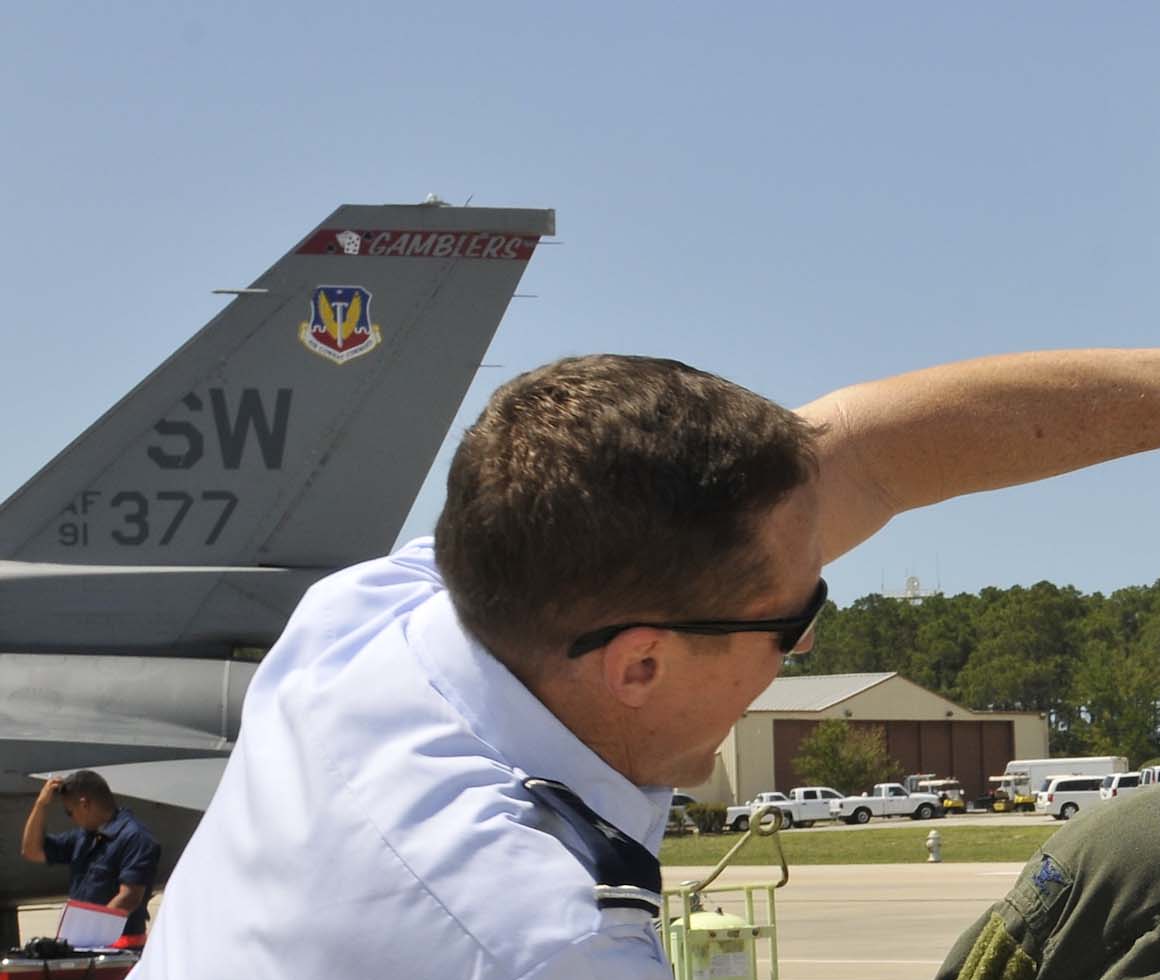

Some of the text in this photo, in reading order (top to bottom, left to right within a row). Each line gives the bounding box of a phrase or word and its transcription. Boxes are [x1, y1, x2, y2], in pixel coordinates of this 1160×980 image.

[367, 231, 521, 258] GAMBLERS
[147, 388, 293, 470] SW
[58, 522, 89, 547] 91
[110, 490, 239, 546] 377
